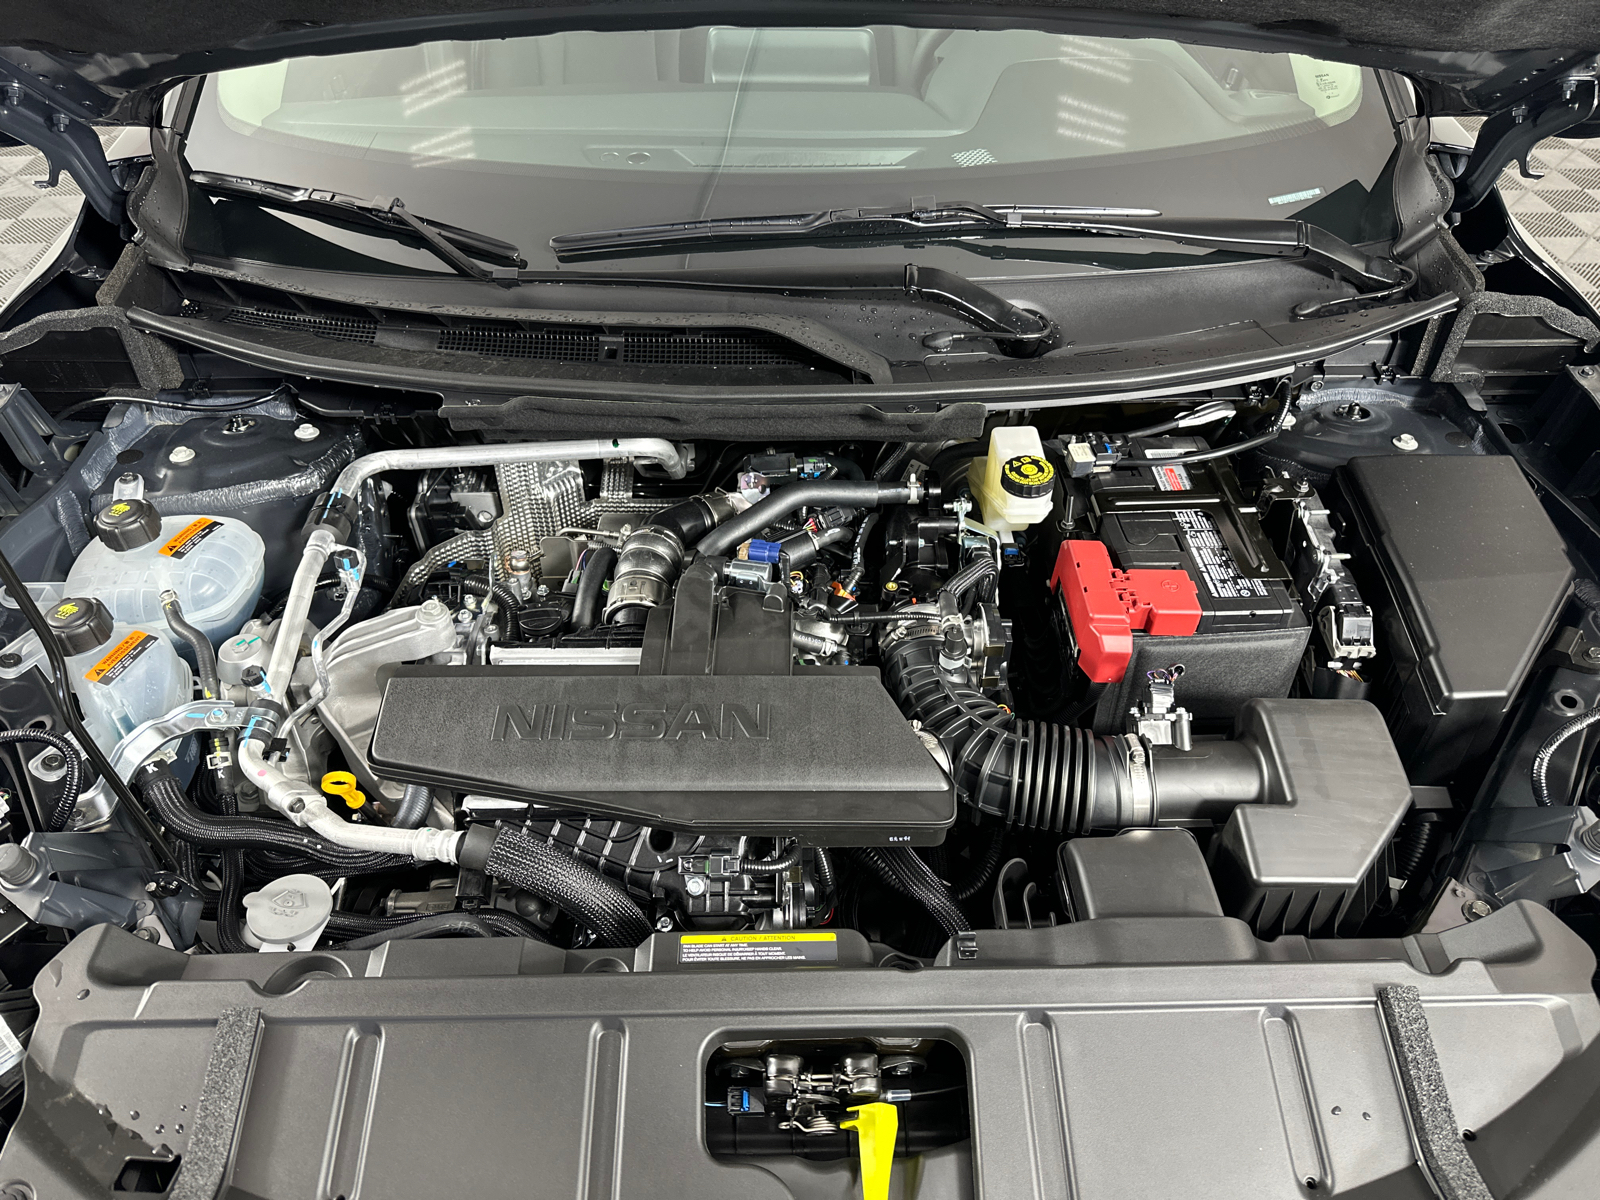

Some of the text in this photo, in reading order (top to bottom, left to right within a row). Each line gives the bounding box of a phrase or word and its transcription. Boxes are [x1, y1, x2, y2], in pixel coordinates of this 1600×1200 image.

[102, 646, 123, 665] WARNING
[107, 635, 141, 667] AVERTISSEMENT
[490, 703, 770, 741] NISSAN
[145, 762, 159, 774] K
[217, 769, 225, 779] K
